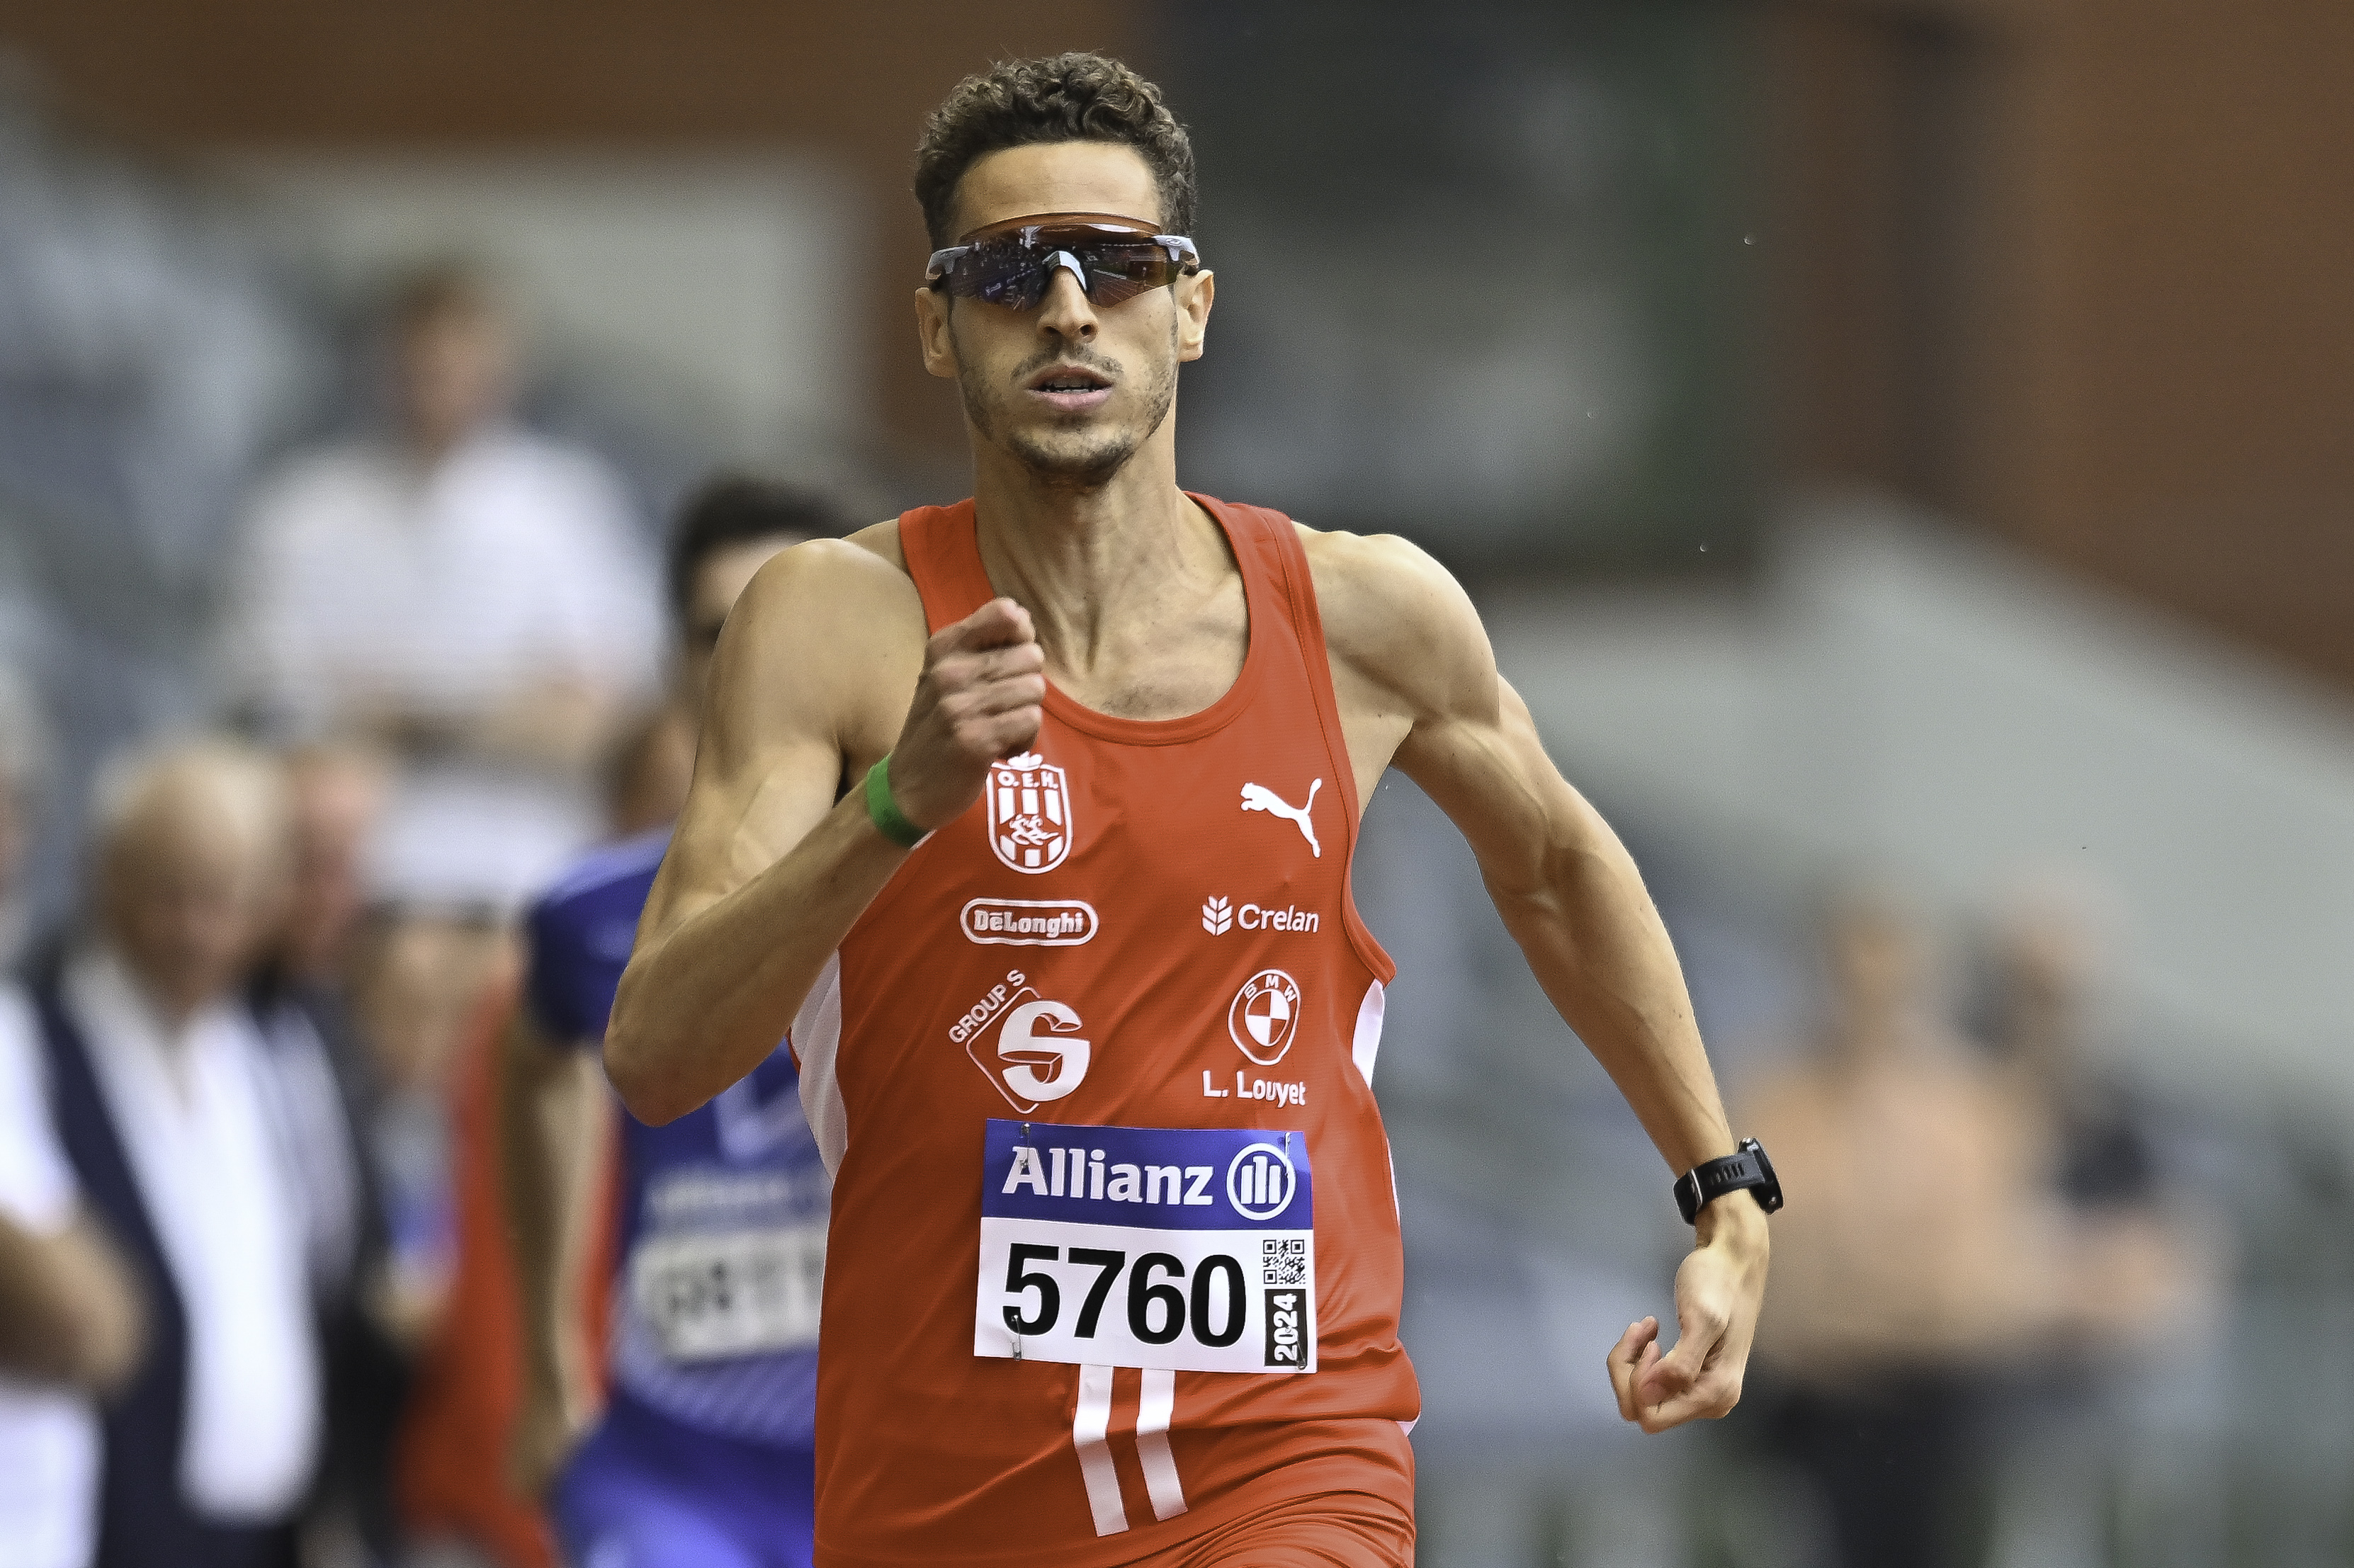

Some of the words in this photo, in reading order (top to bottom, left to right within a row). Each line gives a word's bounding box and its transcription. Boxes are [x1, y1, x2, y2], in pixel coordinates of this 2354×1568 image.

[1238, 903, 1319, 933] Crelan
[948, 983, 1007, 1043] GROUP
[1006, 969, 1026, 987] S
[1243, 975, 1296, 1004] BMW
[997, 1000, 1091, 1103] S
[1202, 1069, 1230, 1098] L.
[1236, 1070, 1306, 1109] Louyet
[1001, 1145, 1214, 1205] Allianz
[1002, 1242, 1247, 1348] 5760
[1273, 1293, 1298, 1362] 2024
